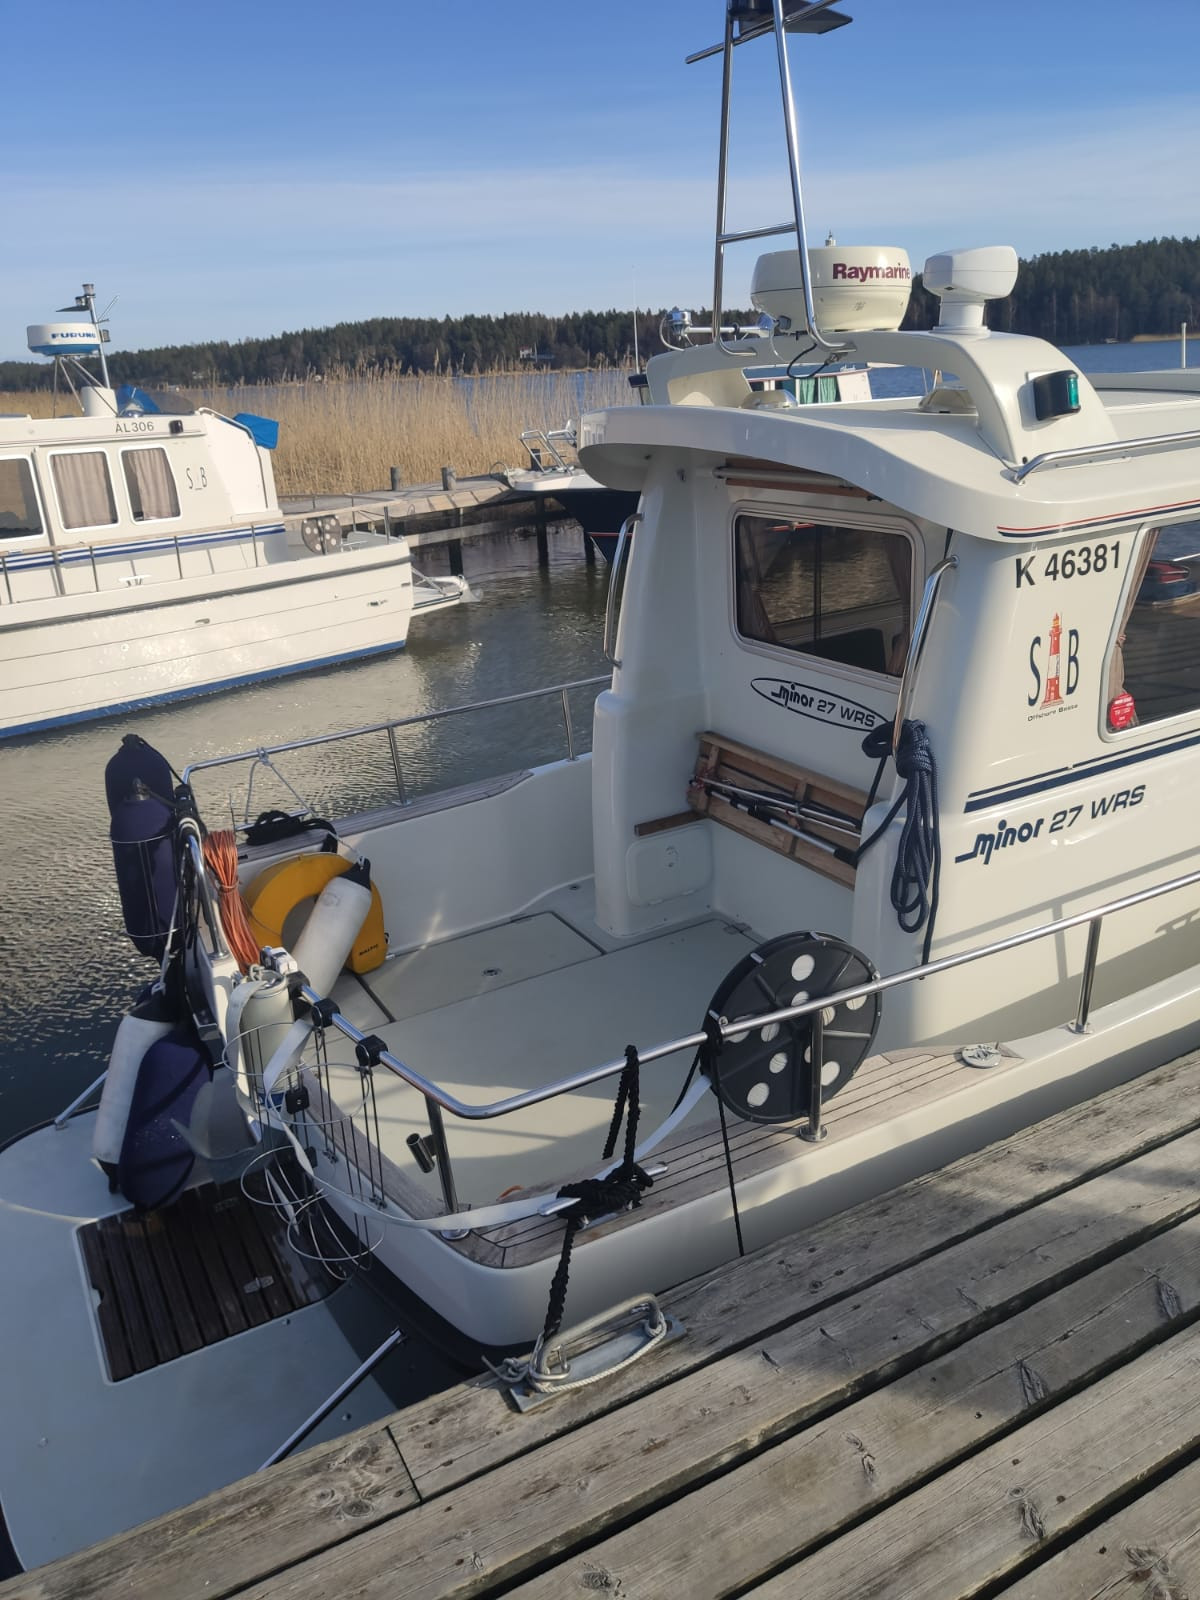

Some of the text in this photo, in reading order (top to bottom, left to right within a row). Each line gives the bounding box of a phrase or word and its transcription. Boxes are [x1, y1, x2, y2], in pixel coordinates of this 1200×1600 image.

[832, 262, 911, 282] Raymarine
[115, 421, 155, 433] AL306
[1015, 540, 1121, 588] K 46381
[816, 699, 837, 714] 27
[840, 705, 876, 728] WRS
[1048, 804, 1084, 834] 27
[1091, 784, 1147, 820] WRS
